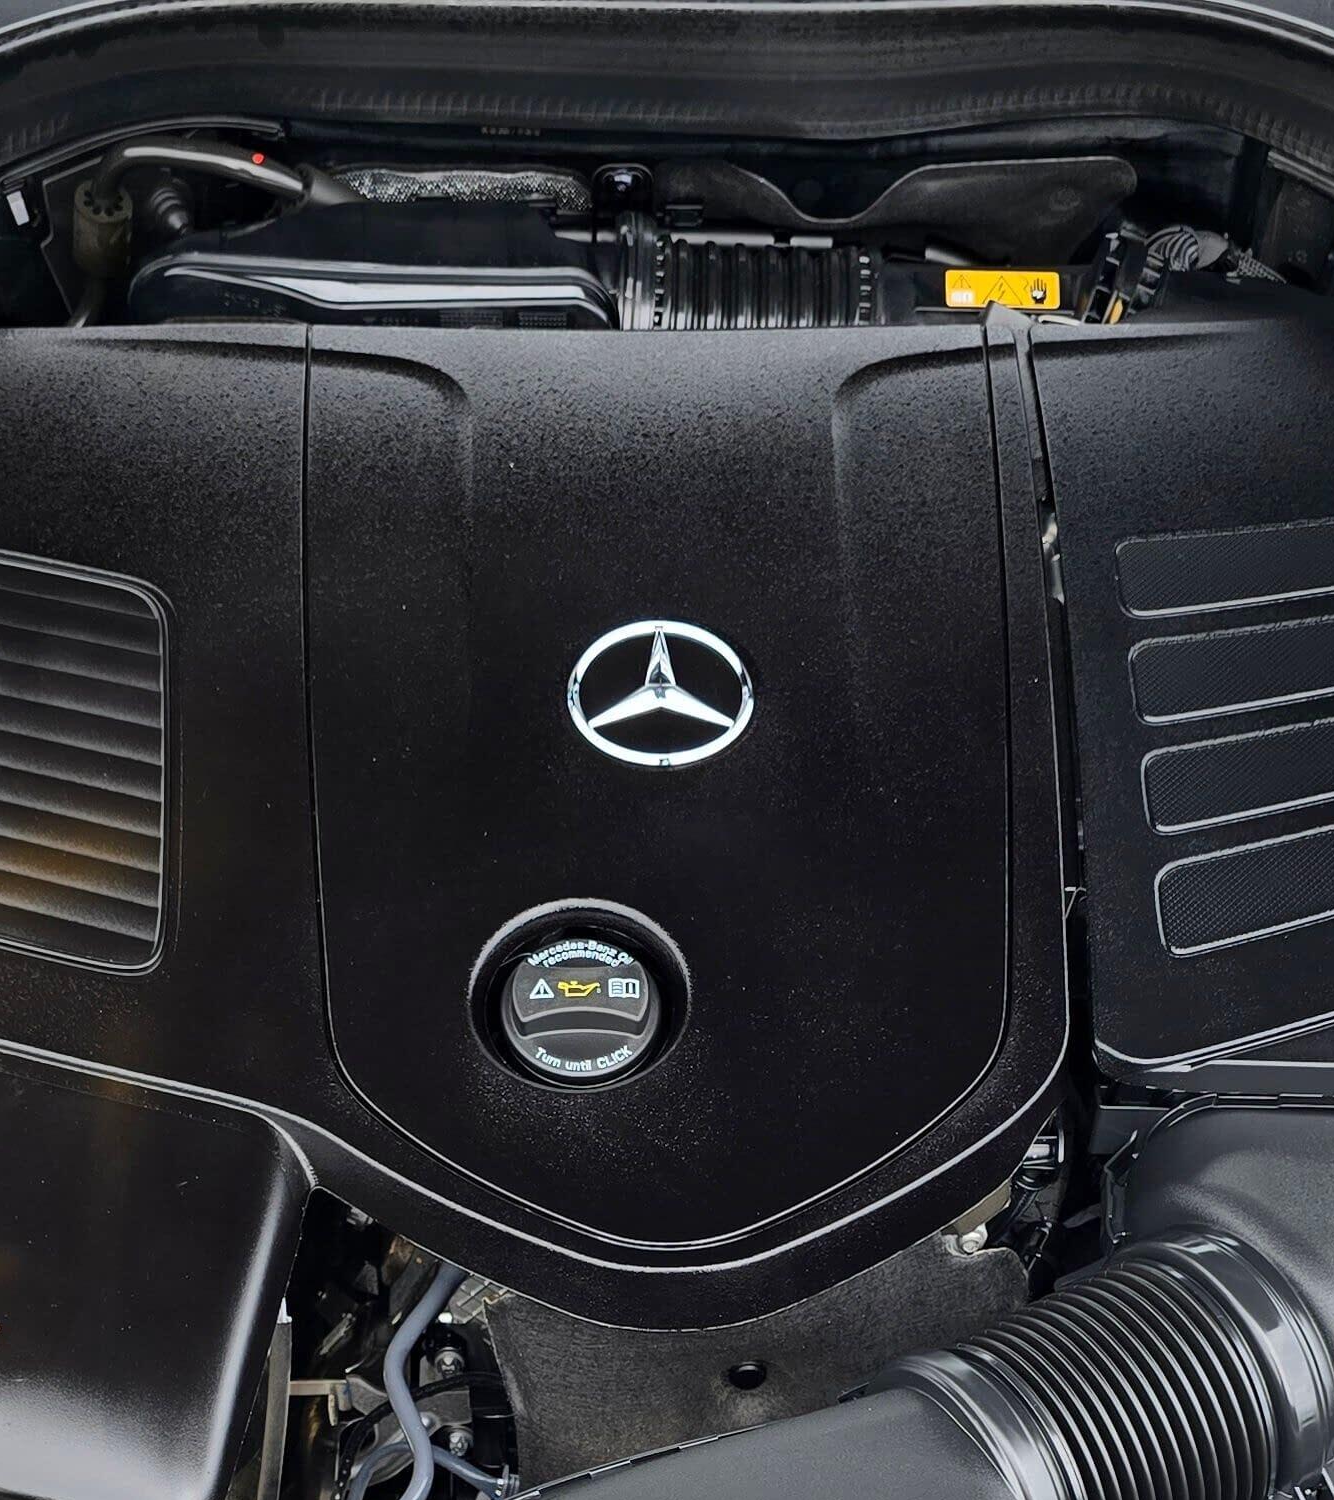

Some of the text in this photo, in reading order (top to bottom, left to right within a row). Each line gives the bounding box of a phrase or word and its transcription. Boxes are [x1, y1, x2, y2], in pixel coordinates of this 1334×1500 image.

[528, 940, 634, 966] Mercedes-Benz Oil
[543, 949, 621, 967] recommended
[535, 1045, 633, 1071] Turn until CLICK
